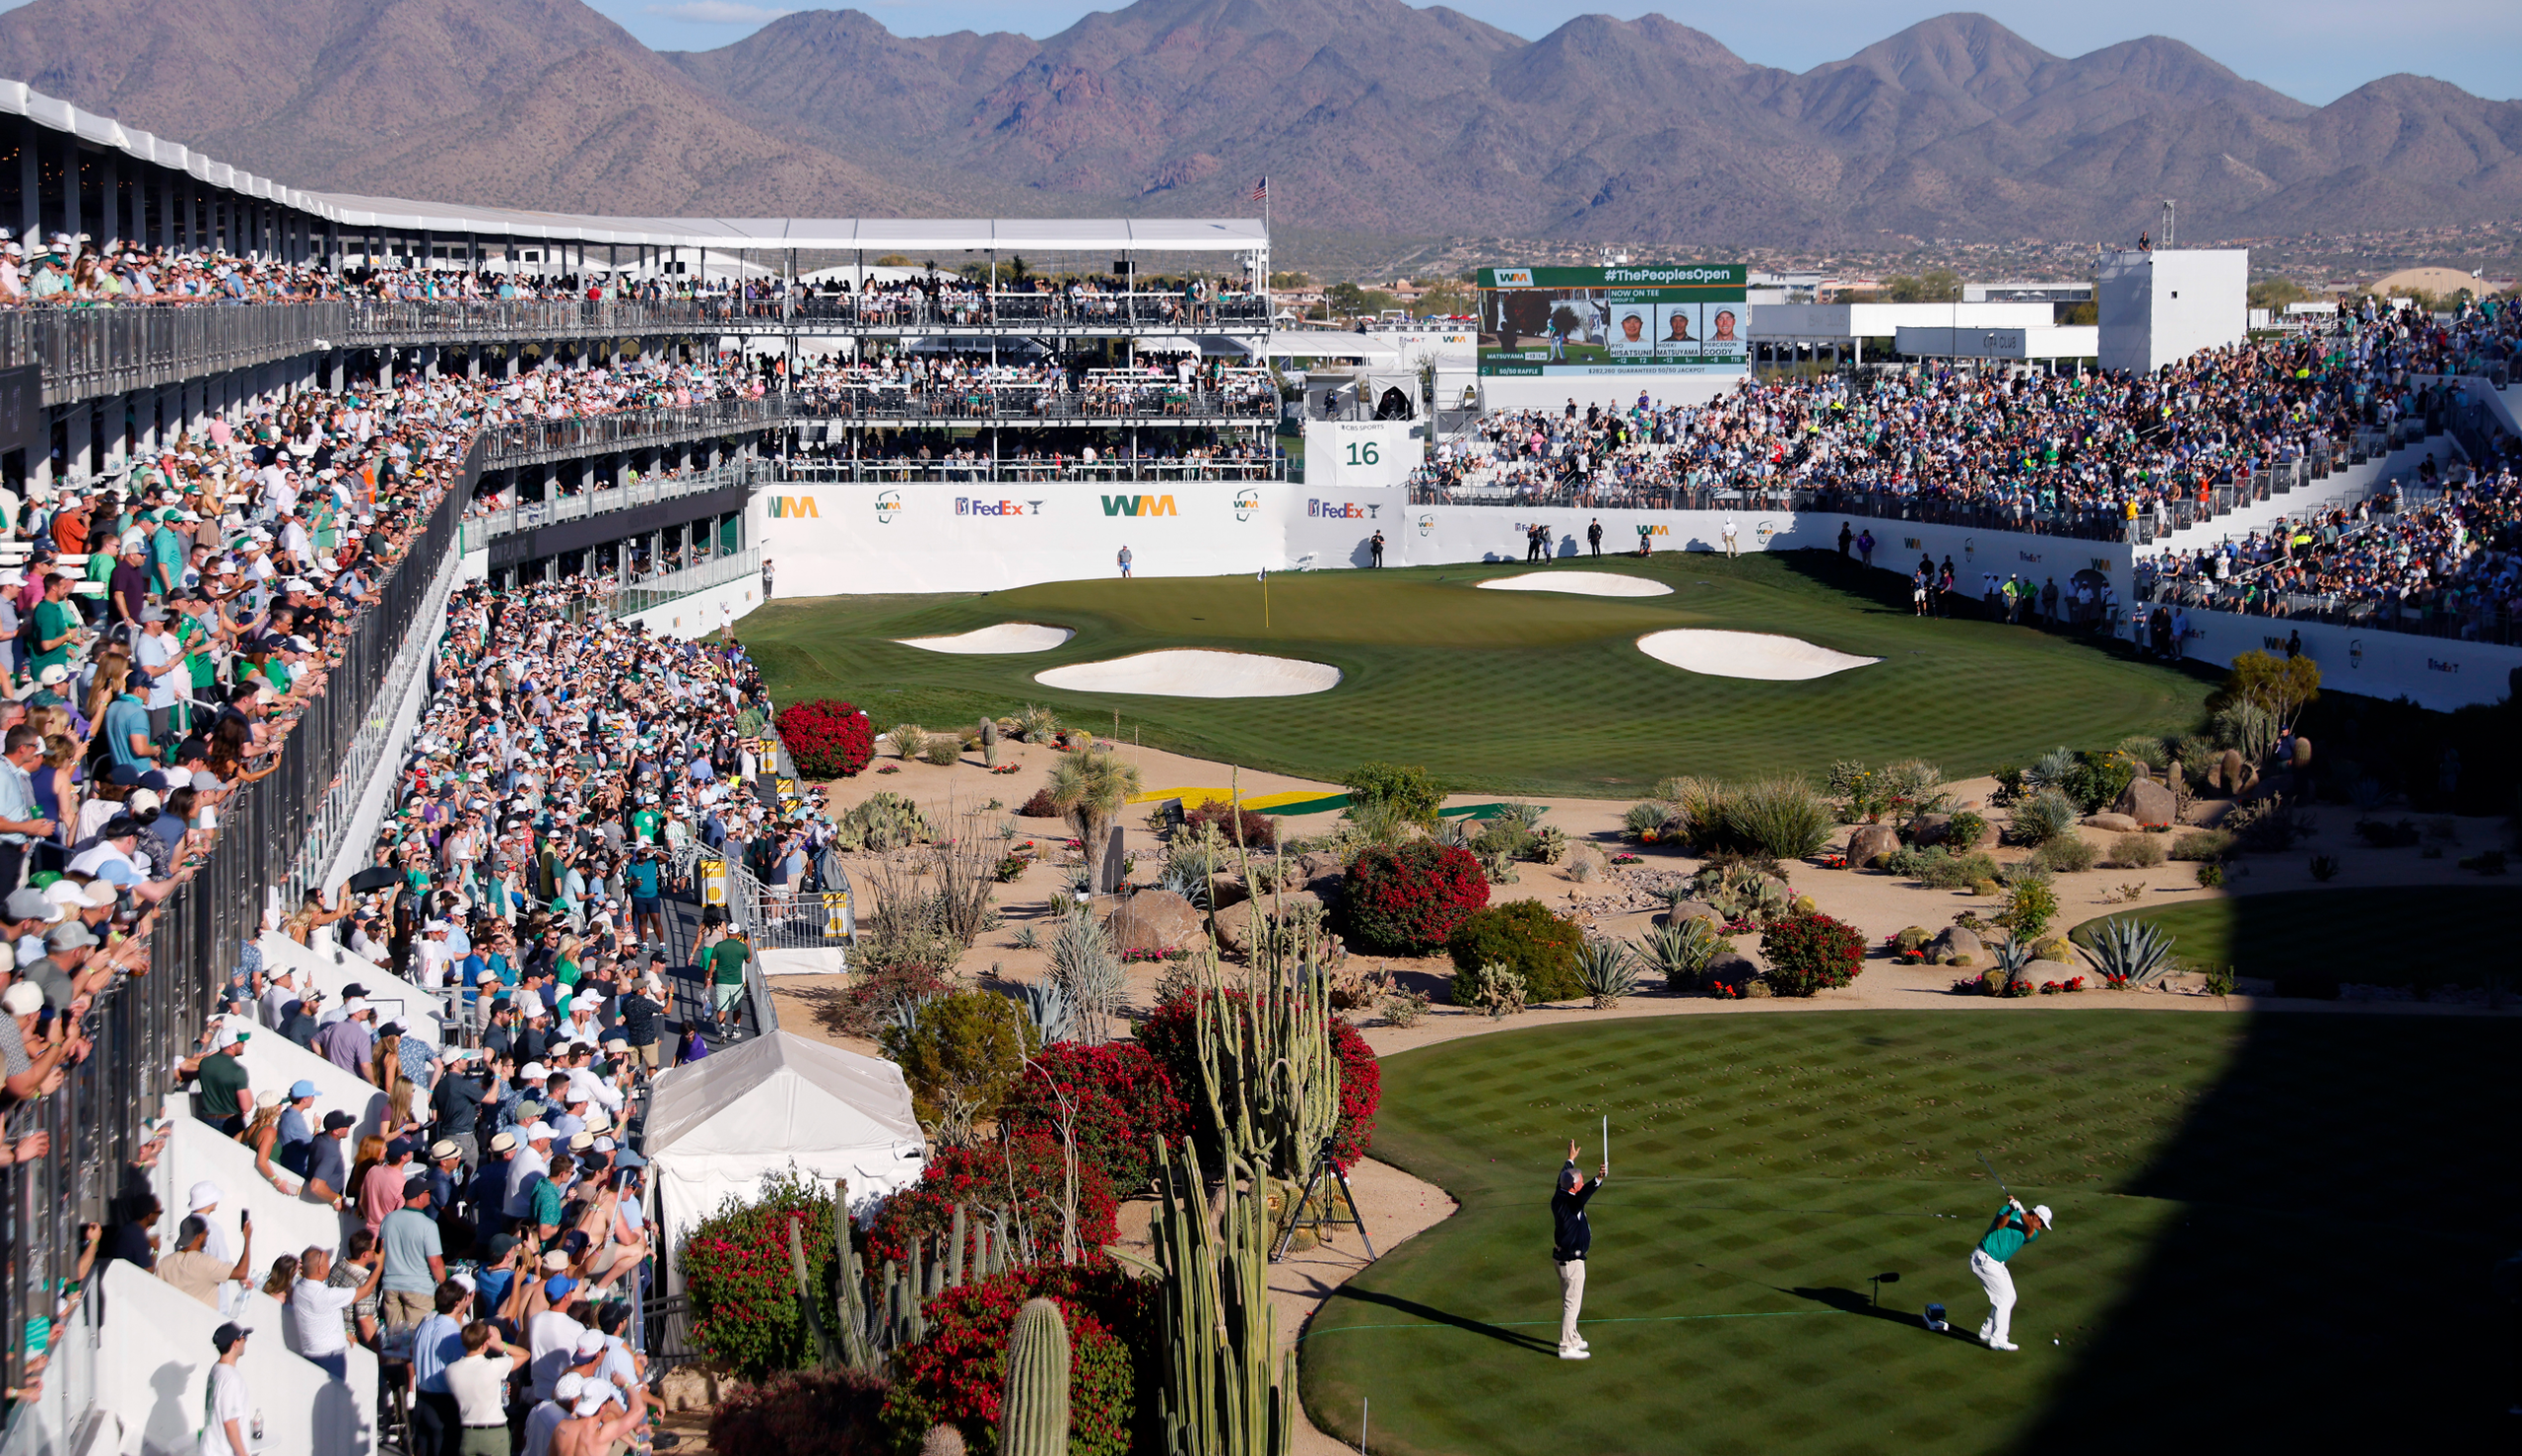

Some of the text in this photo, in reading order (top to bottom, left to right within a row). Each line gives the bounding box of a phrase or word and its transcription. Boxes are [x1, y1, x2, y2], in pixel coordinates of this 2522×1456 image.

[1498, 272, 1528, 283] WM
[1604, 268, 1730, 285] #ThePeoplesOpen
[2000, 336, 2017, 349] CLUB
[1346, 441, 1379, 466] 16
[767, 496, 820, 518] WM
[875, 501, 901, 510] WM
[972, 499, 1024, 516] FedEx
[1100, 495, 1177, 516] WM
[1322, 501, 1364, 519] FedEx
[1635, 524, 1670, 536] WM
[1904, 537, 1922, 551] WM
[2091, 558, 2111, 572] WM
[2263, 635, 2289, 652] WM
